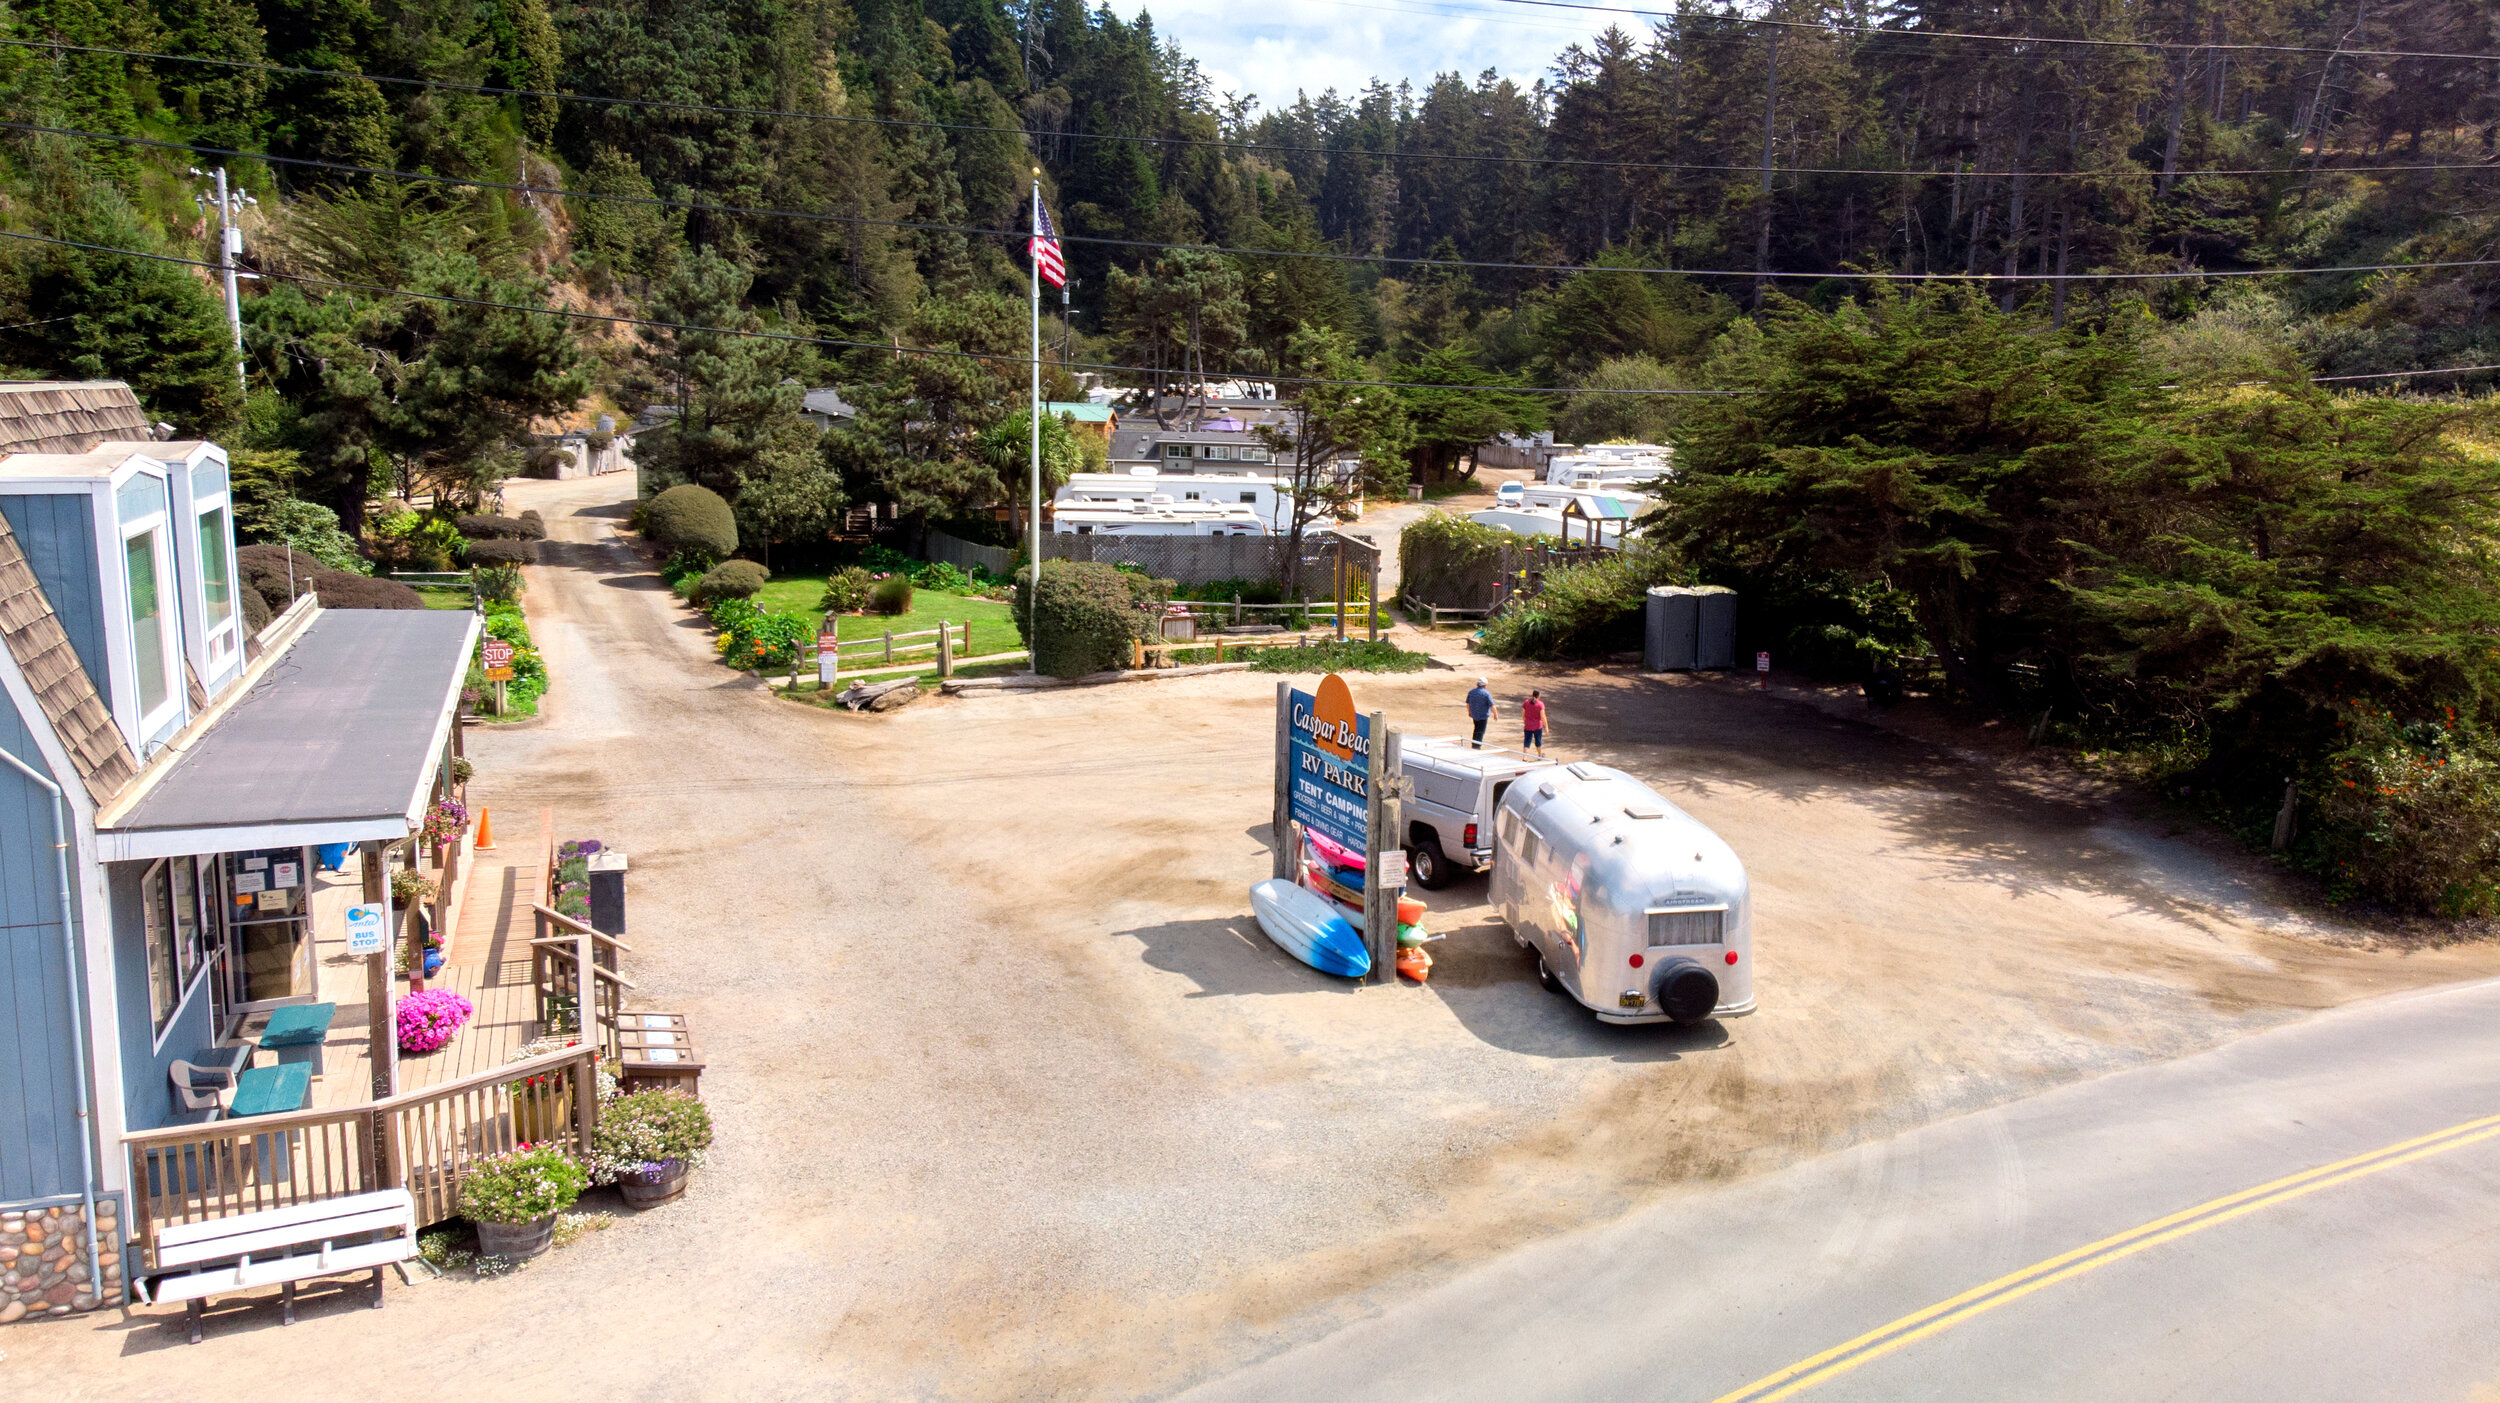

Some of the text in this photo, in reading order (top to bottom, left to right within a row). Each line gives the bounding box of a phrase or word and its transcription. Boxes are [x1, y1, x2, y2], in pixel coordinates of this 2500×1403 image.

[485, 648, 513, 660] STOP
[1293, 703, 1370, 755] Caspar Beac
[1301, 751, 1367, 797] RV PARK
[1293, 790, 1317, 809] GROCERIES
[1320, 803, 1333, 817] BEER
[1333, 810, 1337, 819] &
[1338, 812, 1351, 826] WINE
[1299, 778, 1368, 822] TENT CAMPING
[1294, 807, 1311, 823] FISHING
[1315, 818, 1330, 833] DIVING
[1330, 824, 1344, 840] GEAR
[352, 938, 378, 946] STOP
[355, 931, 374, 939] BUS
